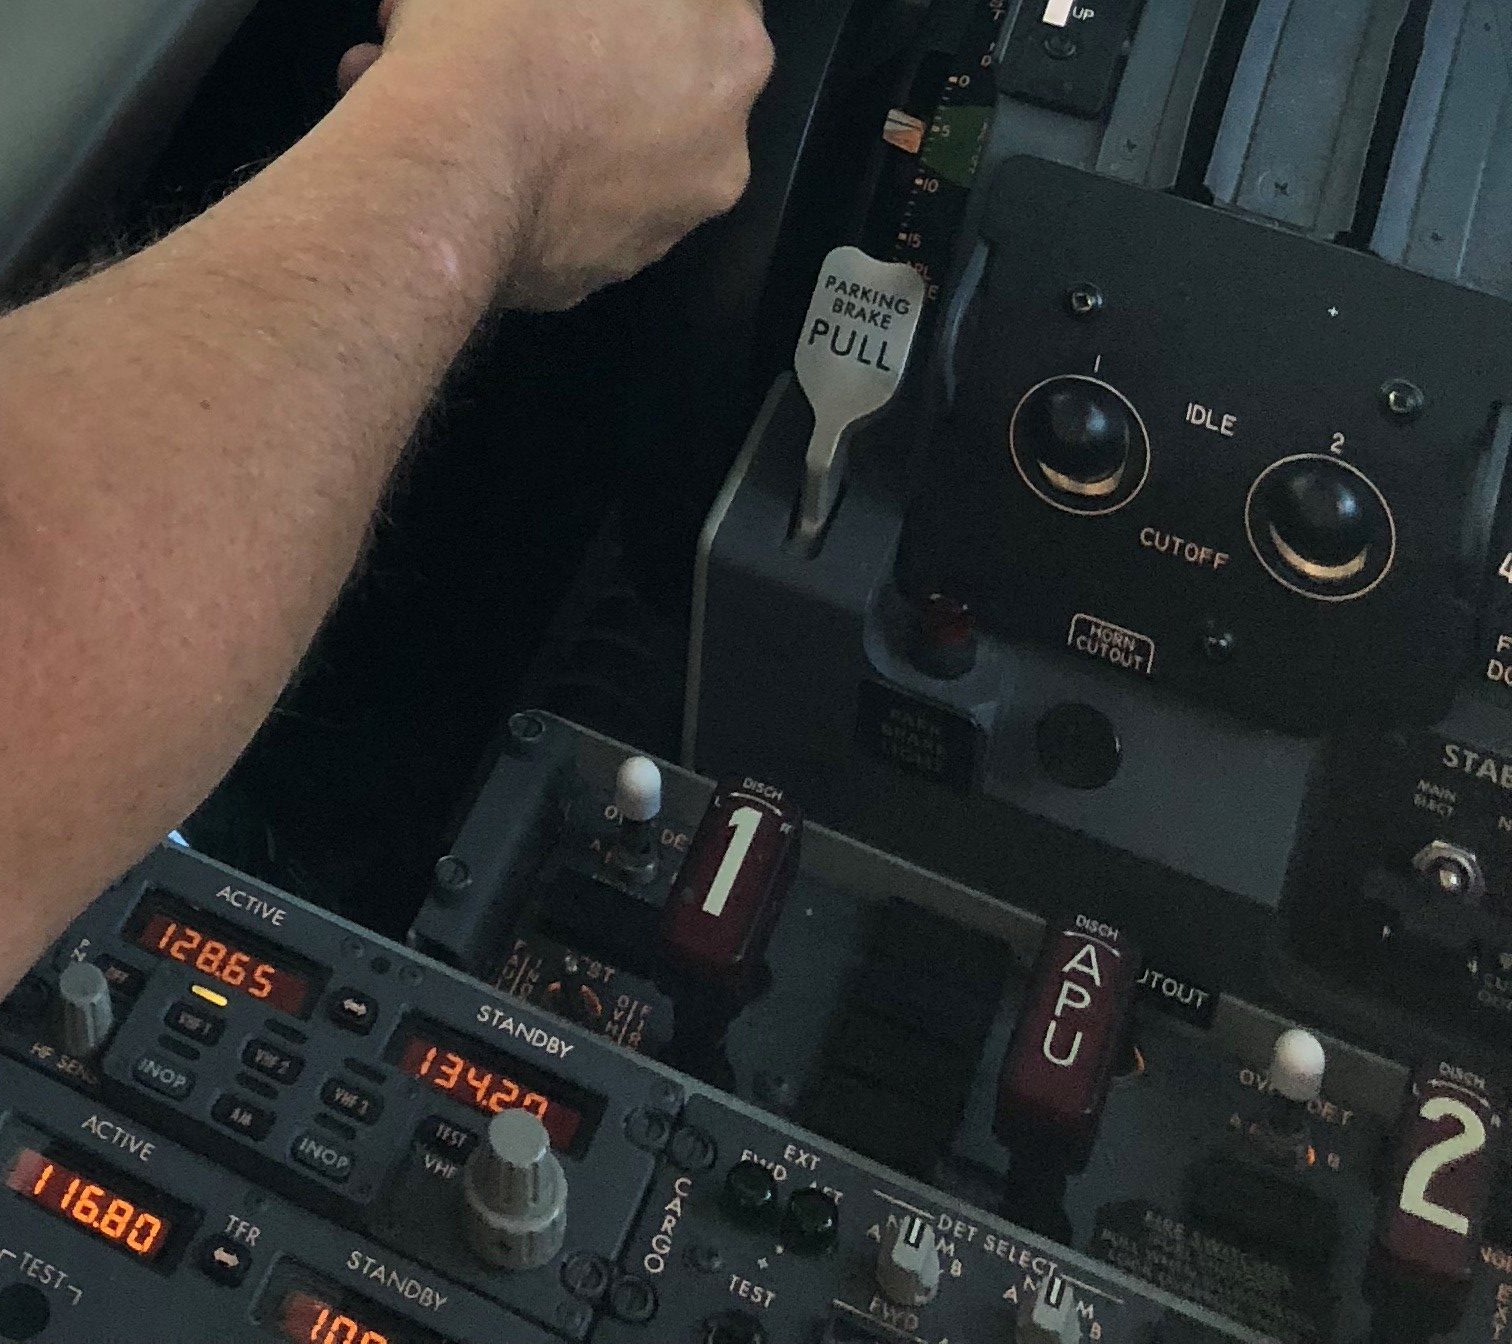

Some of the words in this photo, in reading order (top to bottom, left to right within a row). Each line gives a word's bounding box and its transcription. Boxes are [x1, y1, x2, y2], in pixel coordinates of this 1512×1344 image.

[1072, 5, 1095, 21] UP
[824, 274, 911, 316] PARKING
[830, 296, 892, 330] BRAKE
[807, 318, 892, 373] PULL
[1184, 401, 1237, 437] IDLE
[1330, 432, 1346, 454] 2
[1139, 526, 1229, 570] CUTOFF
[1074, 633, 1144, 671] CUTOUT
[1088, 619, 1137, 651] HORN
[742, 776, 783, 801] DISCH
[702, 805, 763, 917] 1
[216, 884, 285, 928] ACTIVE
[1075, 913, 1119, 941] DISCH
[155, 921, 273, 1000] 128.65
[1042, 943, 1102, 1067] APU
[475, 1004, 573, 1059] STANDBY
[137, 1056, 188, 1089] INOP
[81, 1114, 155, 1163] ACTIVE
[298, 1137, 350, 1169] INOP
[783, 1145, 821, 1172] EXT
[1400, 1096, 1486, 1236] 2
[30, 1163, 163, 1254] 116.80
[643, 1177, 692, 1273] CARGO
[223, 1214, 262, 1245] TFR
[936, 1215, 978, 1243] DET
[984, 1235, 1058, 1279] SELECT
[19, 1251, 68, 1288] TEST
[347, 1250, 447, 1311] STANDBY
[727, 1274, 777, 1310] TEST
